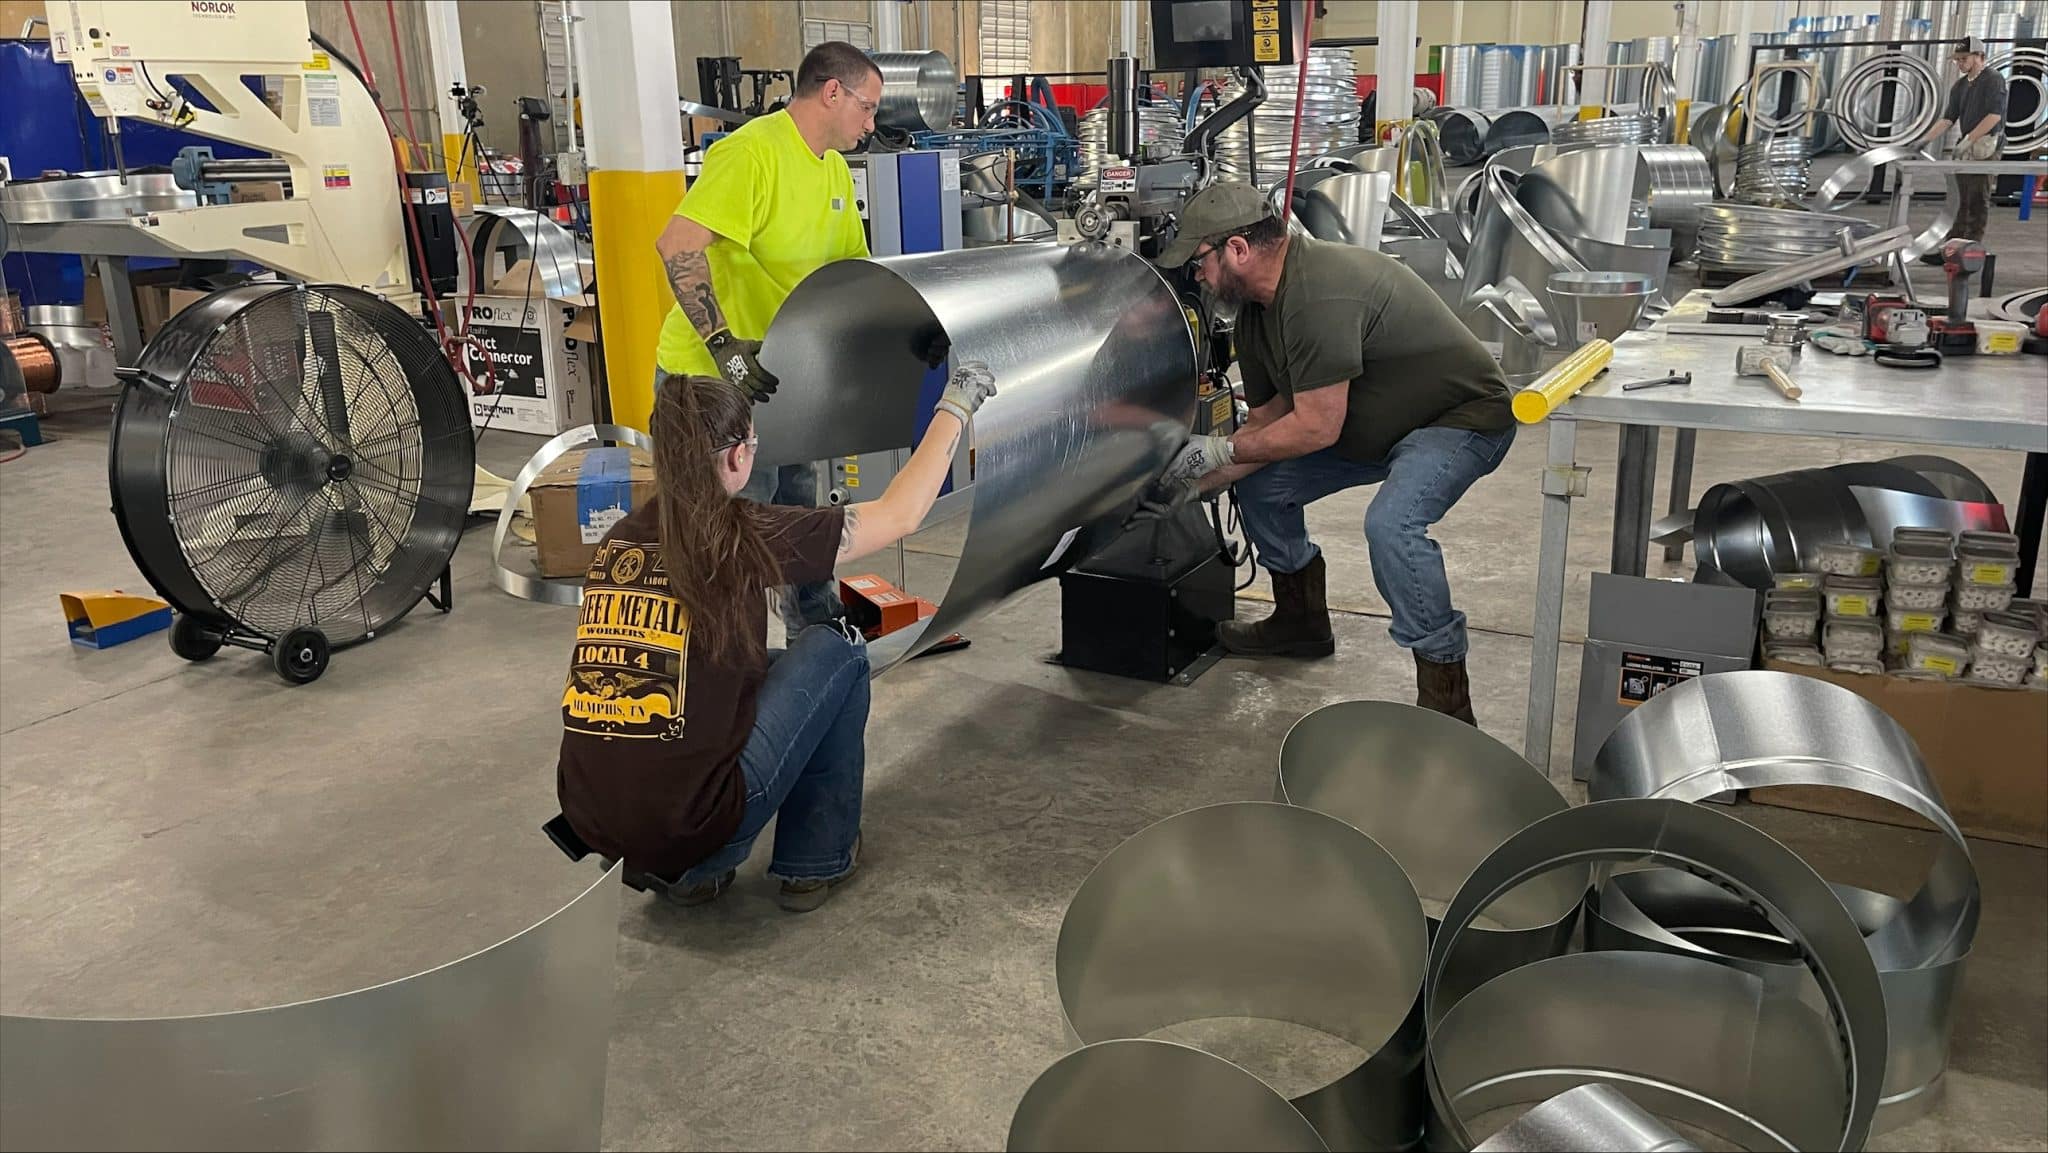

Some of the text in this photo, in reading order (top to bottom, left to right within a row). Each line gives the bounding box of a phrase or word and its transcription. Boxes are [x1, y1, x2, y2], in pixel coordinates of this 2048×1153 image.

[191, 1, 236, 14] NORLOK
[1186, 449, 1202, 465] CUT
[643, 576, 669, 586] LABOR
[579, 593, 684, 635] HEET METAL
[586, 627, 646, 638] WORKERS
[578, 646, 650, 669] LOCAL 4
[574, 699, 645, 717] MEMPHIS, TN
